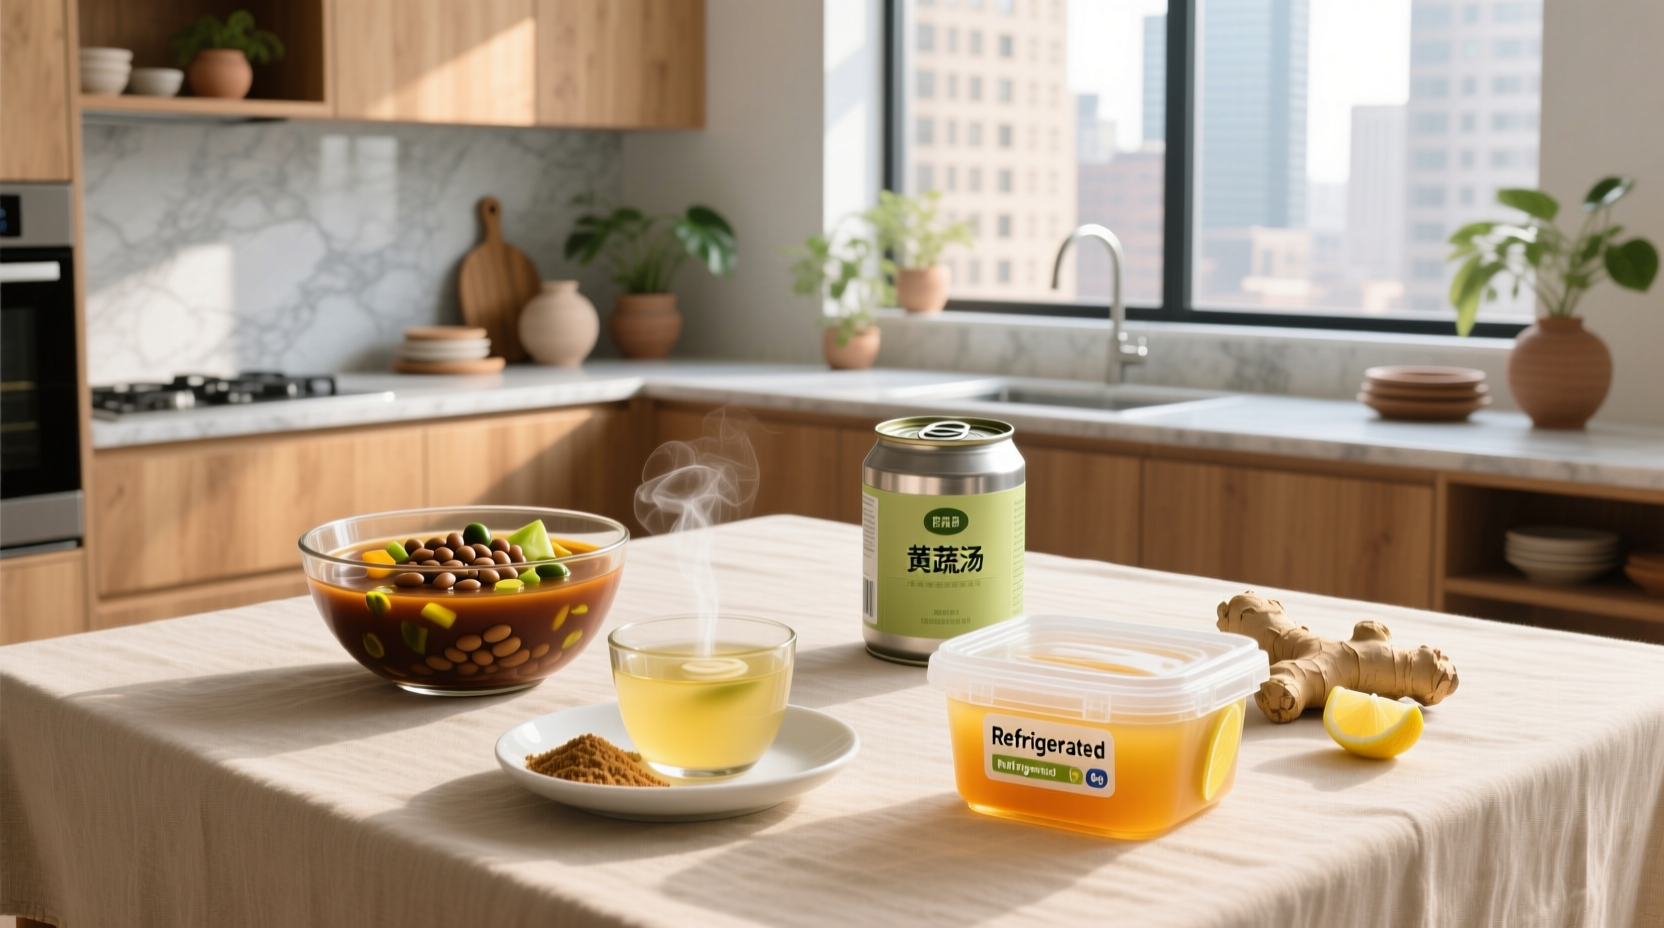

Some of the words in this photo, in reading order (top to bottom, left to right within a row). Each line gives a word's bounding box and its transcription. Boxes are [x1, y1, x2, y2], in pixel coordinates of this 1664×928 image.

[907, 544, 984, 574] 黄蔬汤
[992, 725, 1105, 760] Refrigerated
